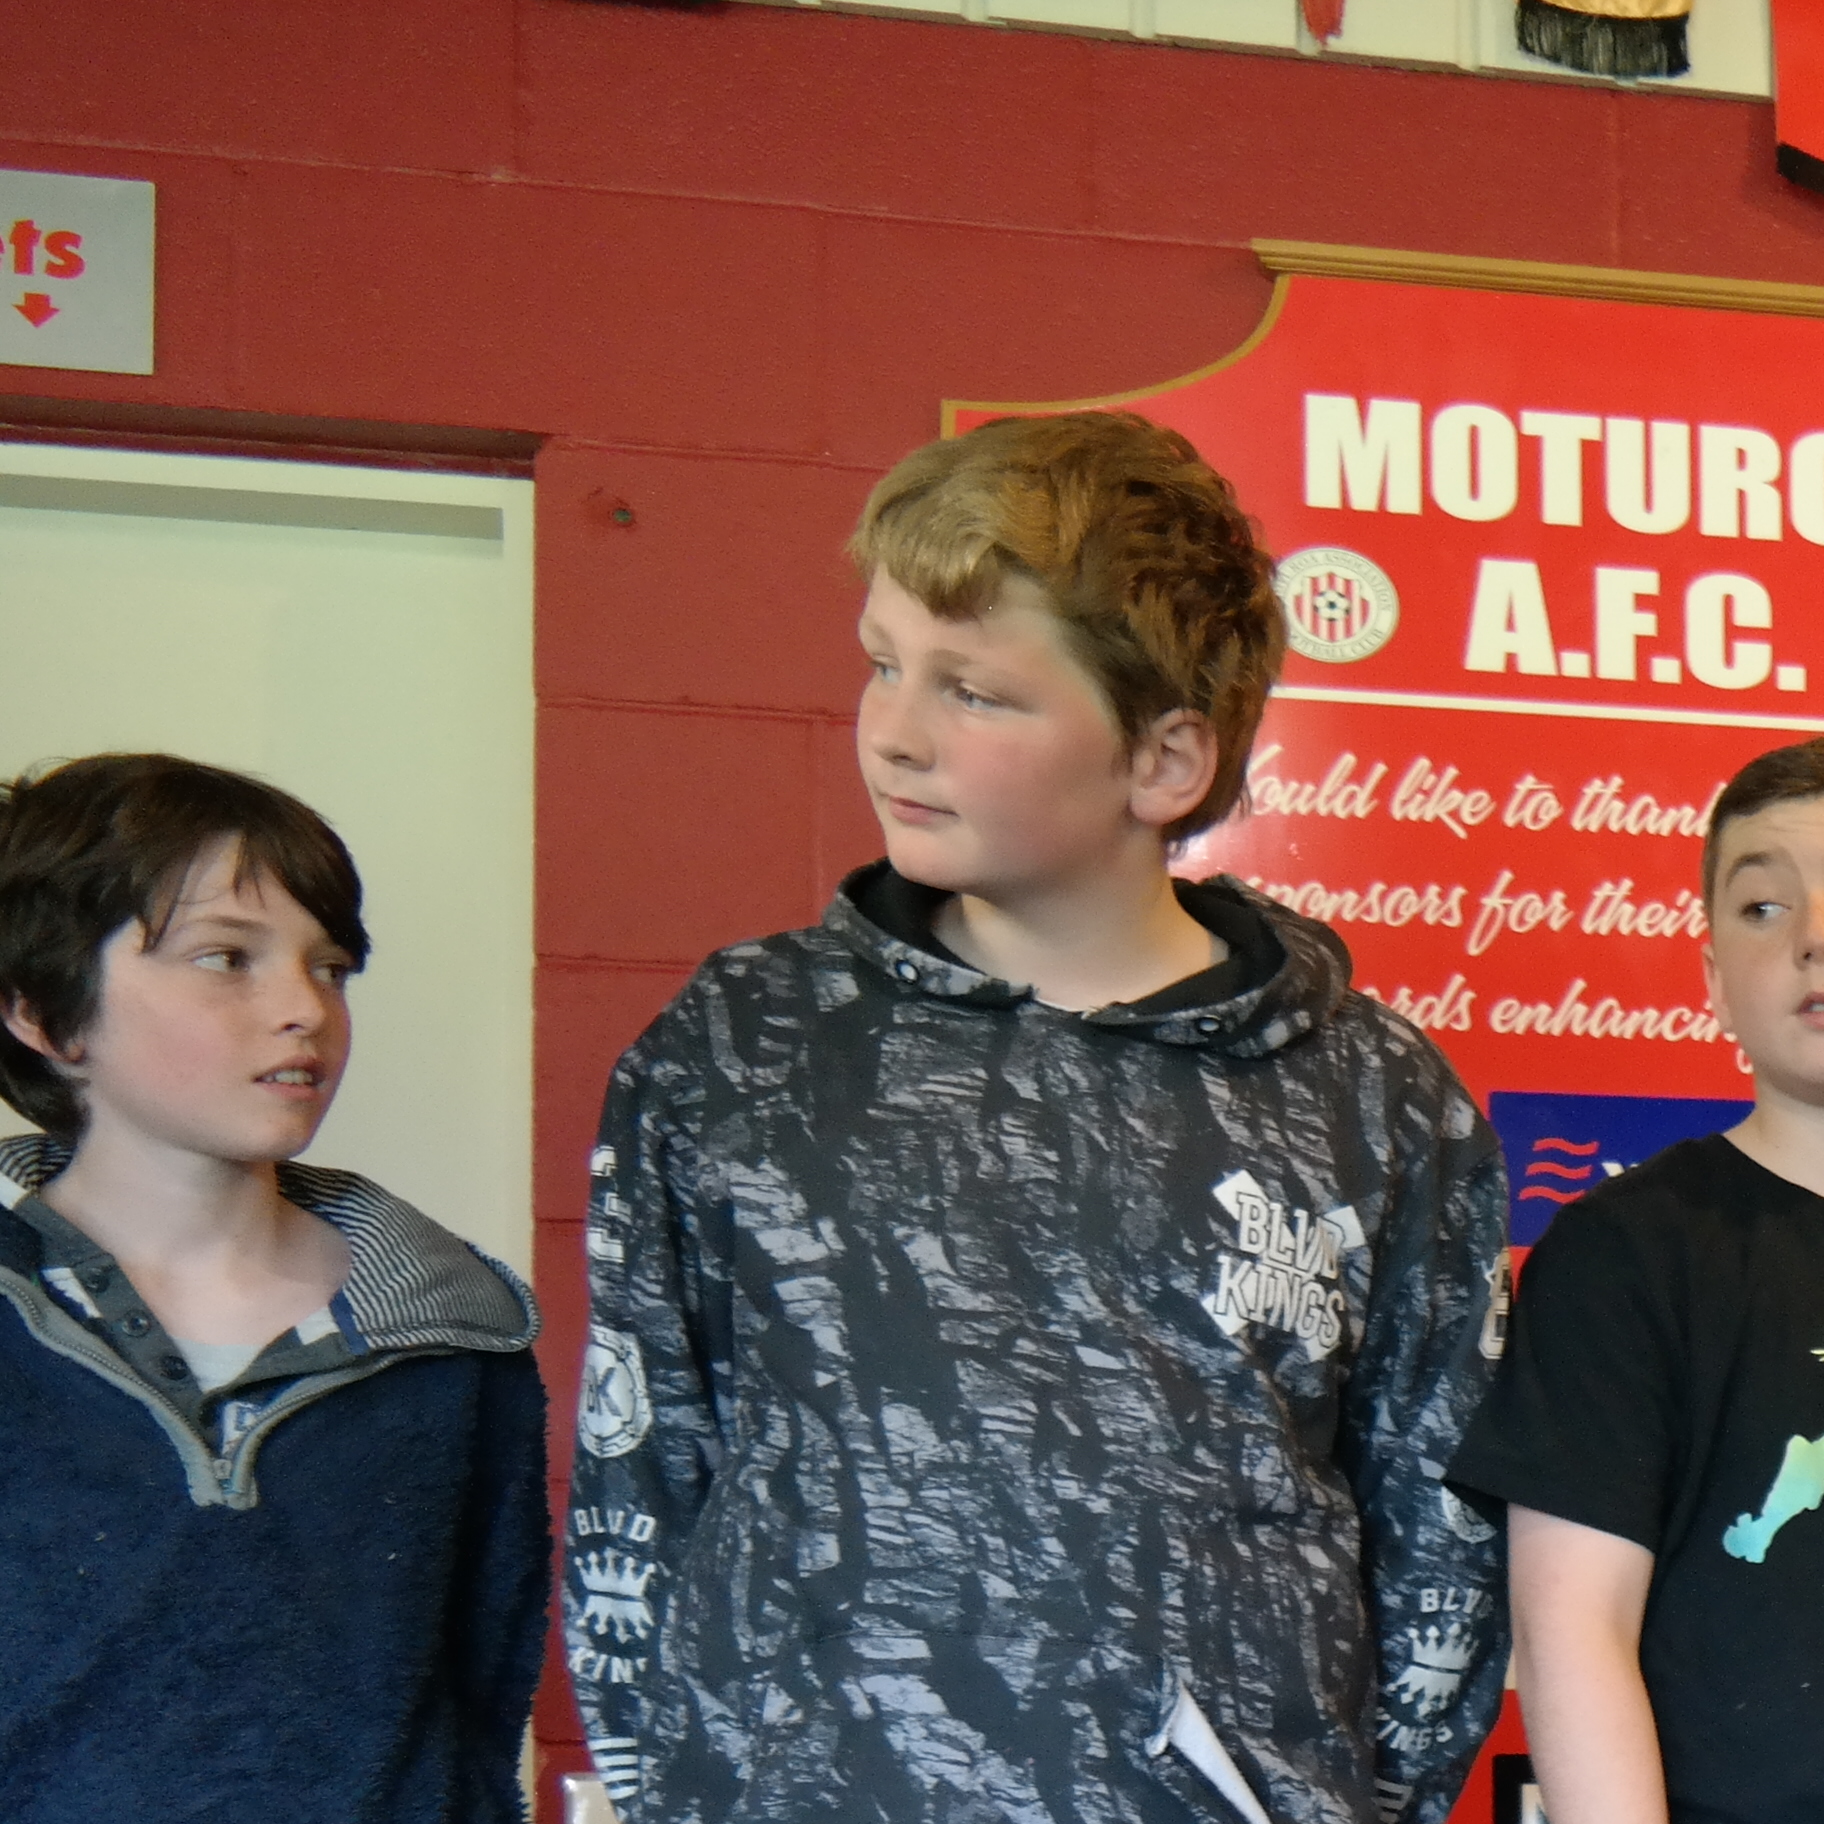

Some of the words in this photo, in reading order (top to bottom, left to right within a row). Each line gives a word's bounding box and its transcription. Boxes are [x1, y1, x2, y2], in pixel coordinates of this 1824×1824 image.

[0, 219, 87, 280] ts
[1464, 558, 1807, 693] A.F.C.
[1391, 756, 1496, 840] like
[1503, 774, 1564, 832] to
[1466, 869, 1574, 957] for
[1581, 878, 1710, 939] their
[1237, 1191, 1345, 1280] BLVD
[1214, 1255, 1345, 1349] KINGS
[573, 1508, 657, 1542] BLVD
